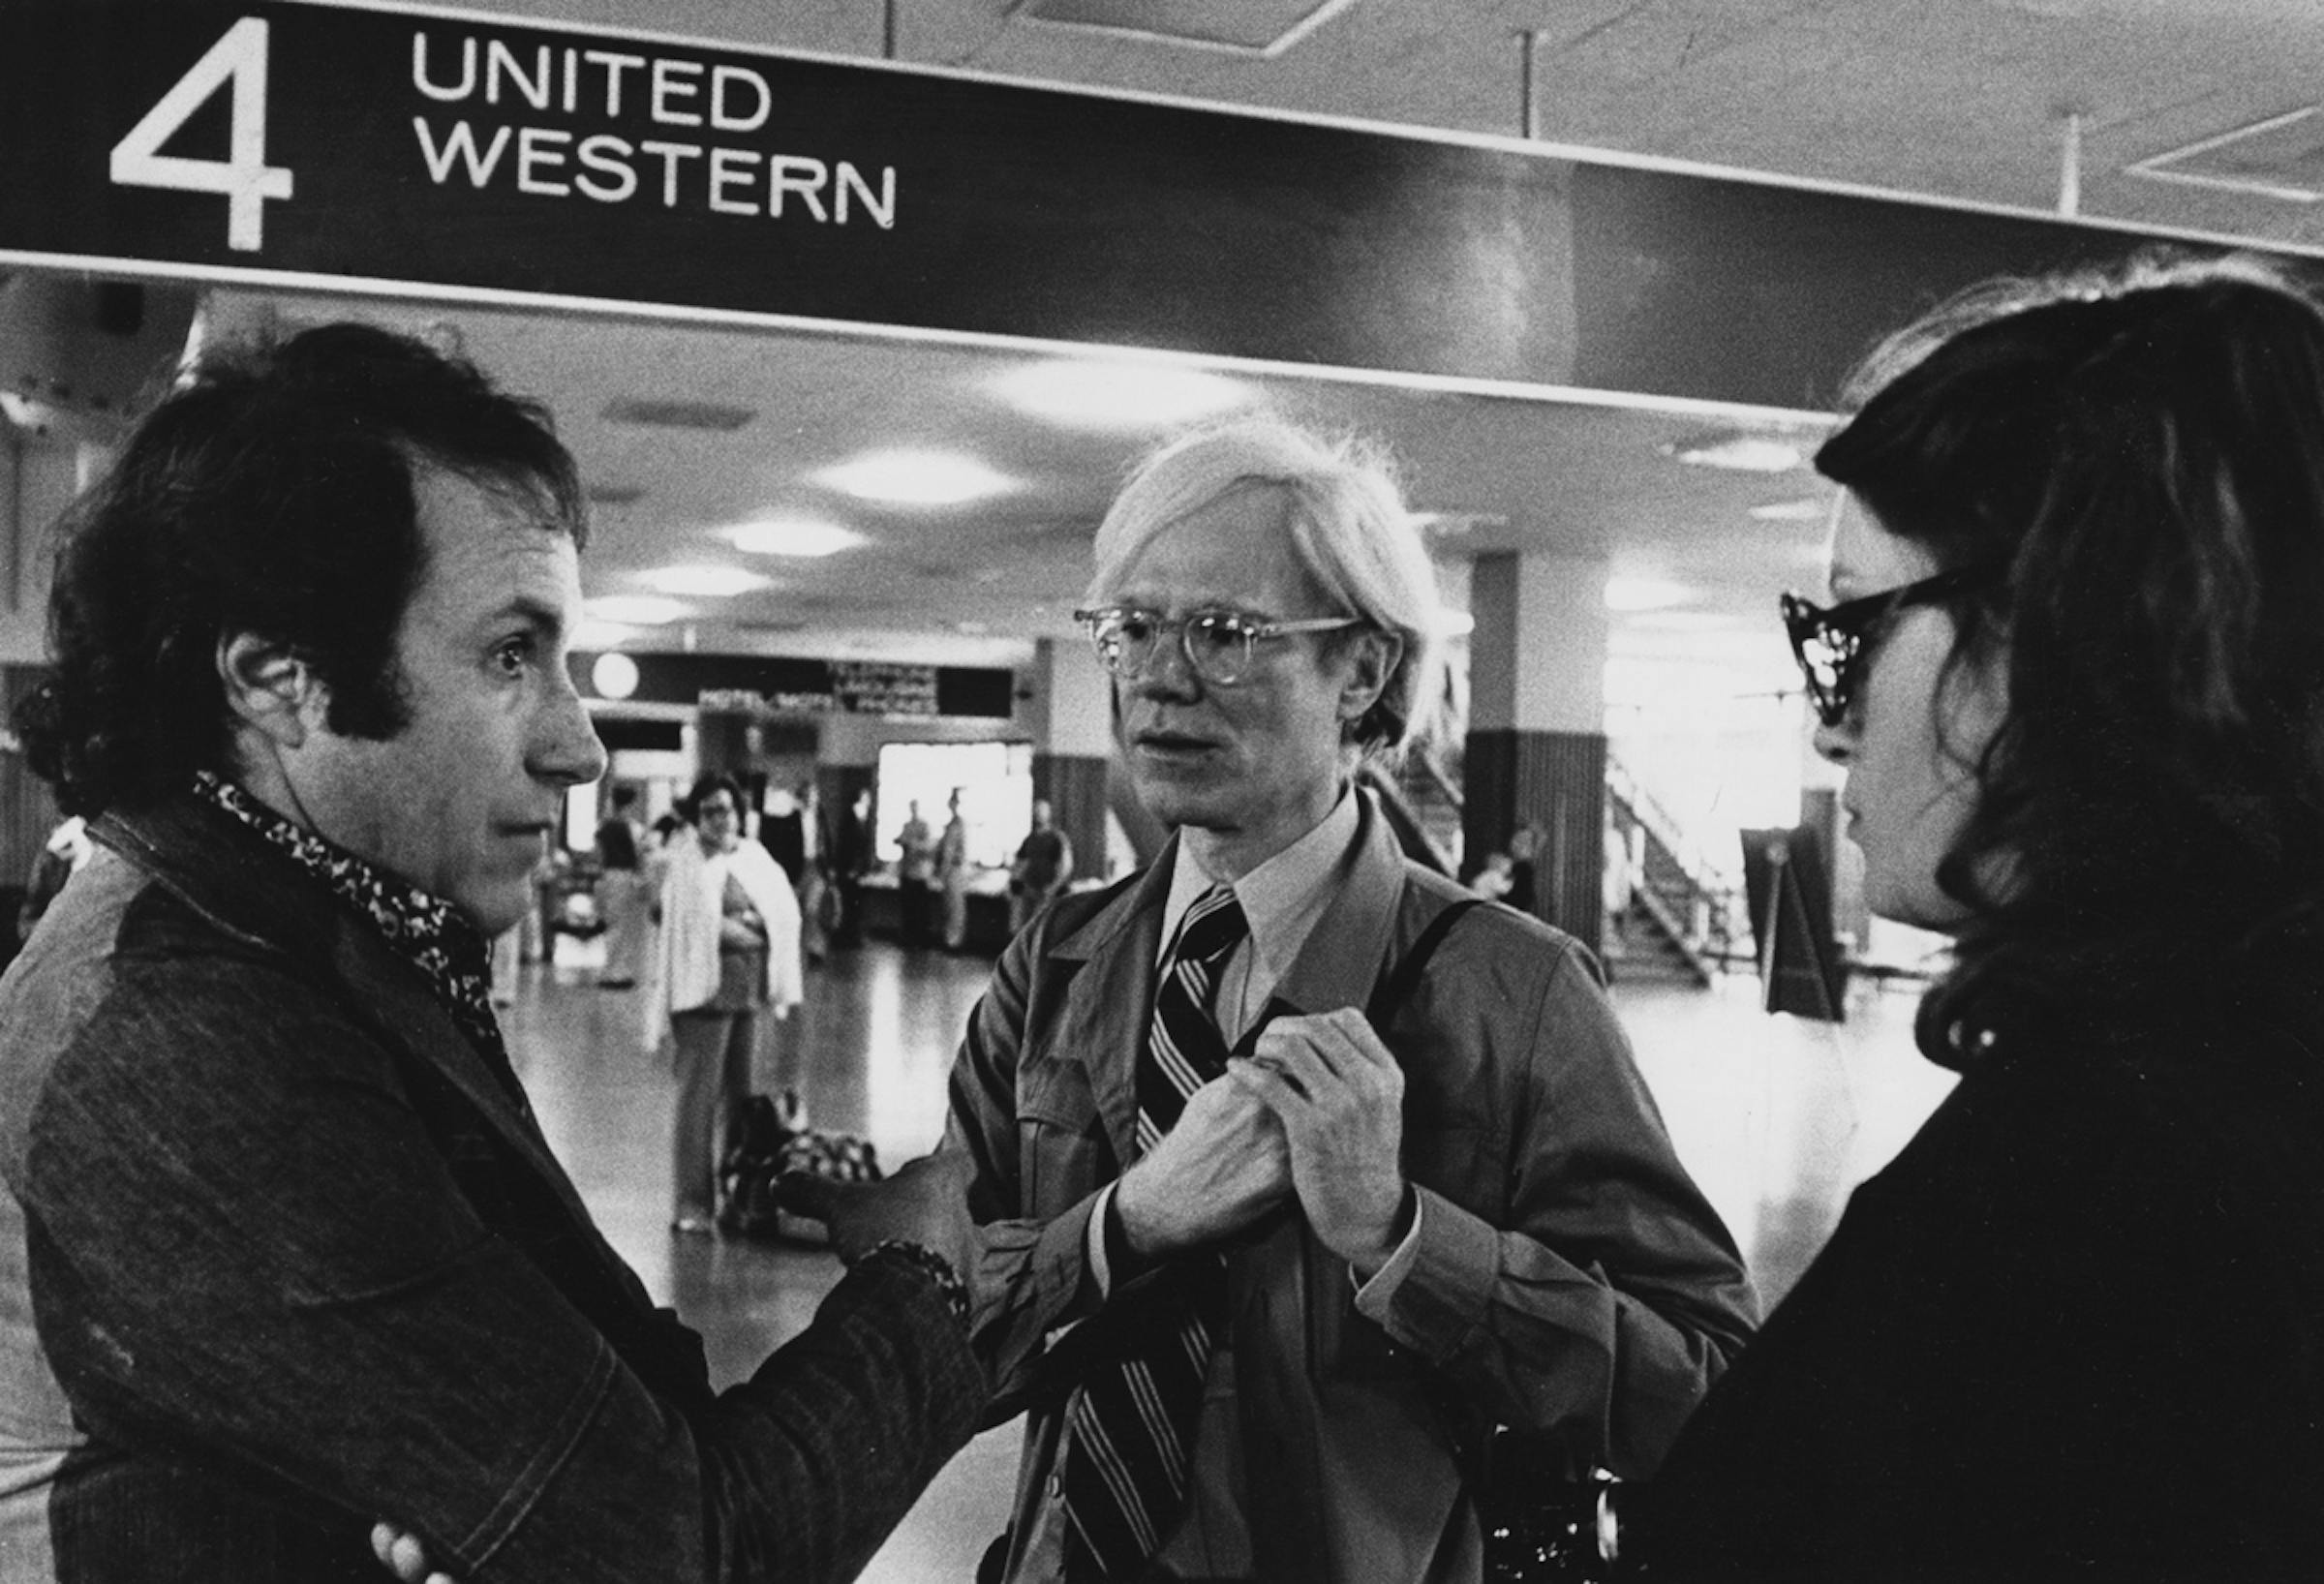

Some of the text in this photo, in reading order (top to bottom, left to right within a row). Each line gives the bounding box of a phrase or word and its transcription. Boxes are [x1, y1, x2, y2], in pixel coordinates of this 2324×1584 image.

[110, 17, 292, 251] 4
[413, 32, 771, 131] UNITED
[413, 116, 896, 229] WESTERN
